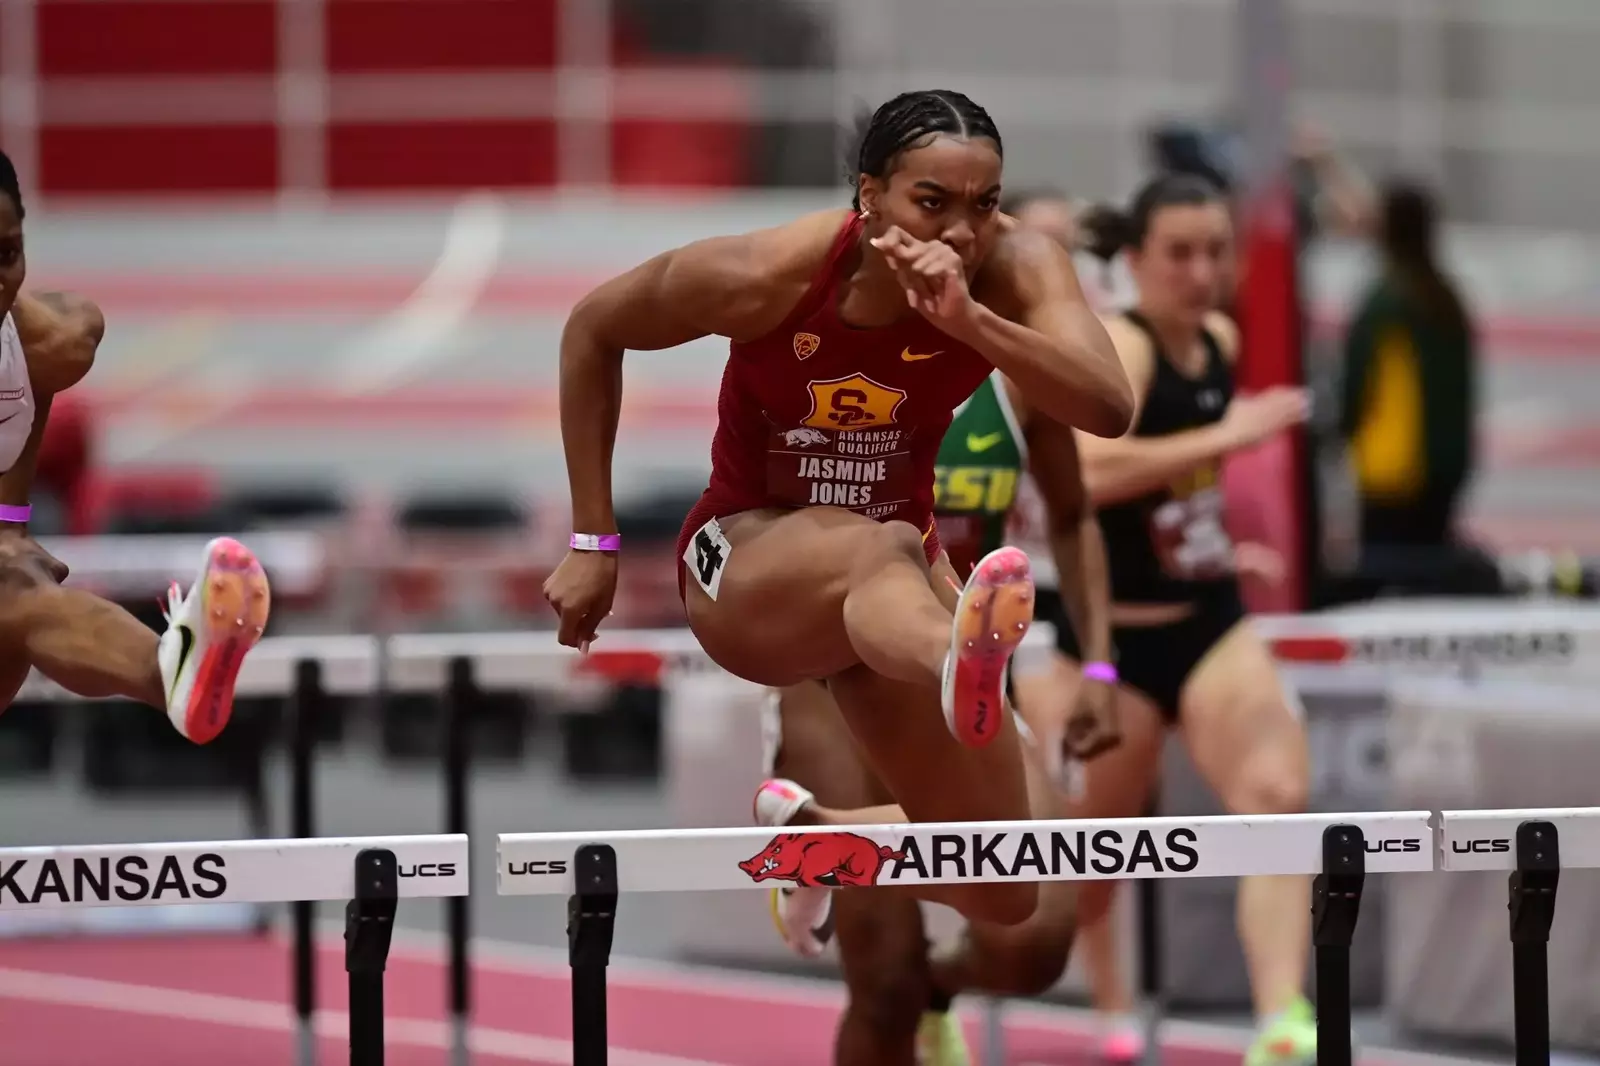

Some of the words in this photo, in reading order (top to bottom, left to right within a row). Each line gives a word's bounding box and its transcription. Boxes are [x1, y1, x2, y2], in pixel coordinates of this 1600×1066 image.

[838, 430, 902, 442] ARKANSAS
[837, 441, 898, 455] QUALIFIER
[797, 457, 886, 482] JASMINE
[809, 482, 872, 506] JONES
[694, 526, 724, 587] 4
[890, 827, 1200, 879] ARKANSAS
[1364, 838, 1421, 854] UCS
[1452, 838, 1511, 854] UCS
[397, 863, 457, 878] UCS
[508, 860, 567, 876] UCS
[0, 853, 228, 904] KANSAS
